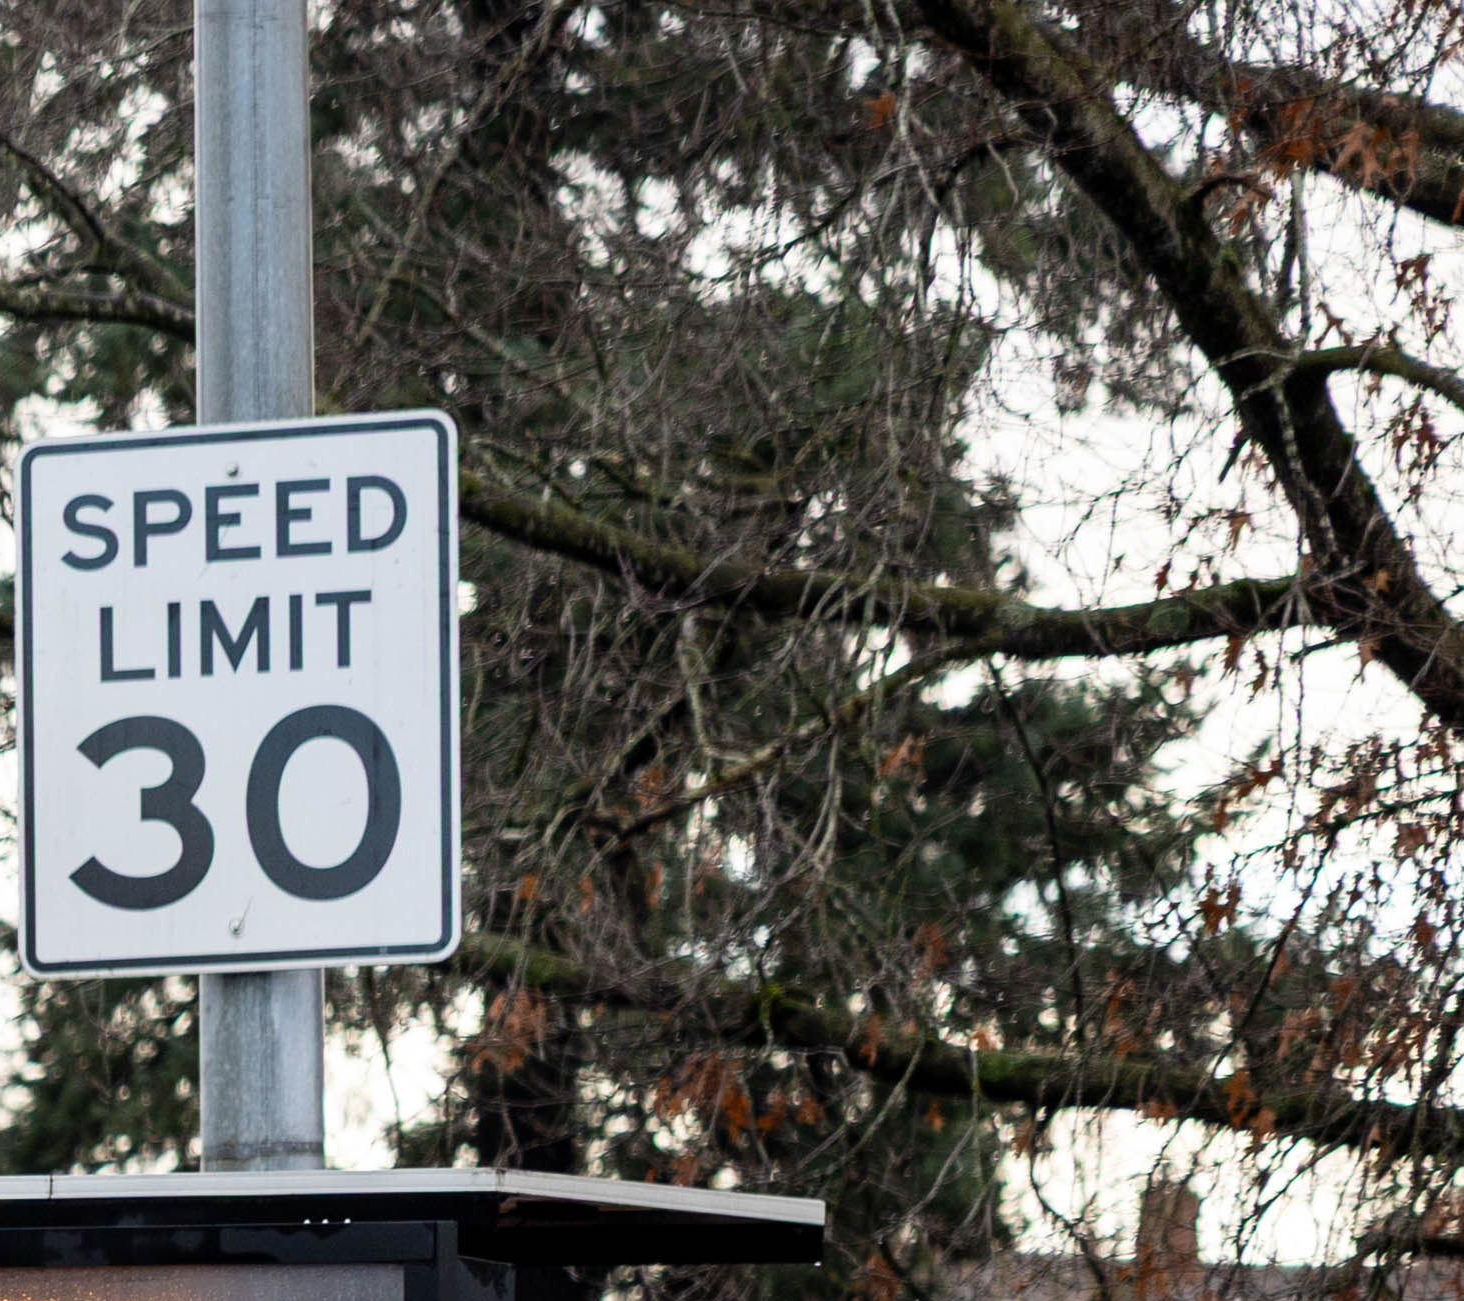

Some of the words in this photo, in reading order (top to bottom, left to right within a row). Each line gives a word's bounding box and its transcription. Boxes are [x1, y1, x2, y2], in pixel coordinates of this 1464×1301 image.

[61, 474, 408, 571] SPEED
[99, 589, 373, 683] LIMIT
[68, 703, 402, 912] 30
